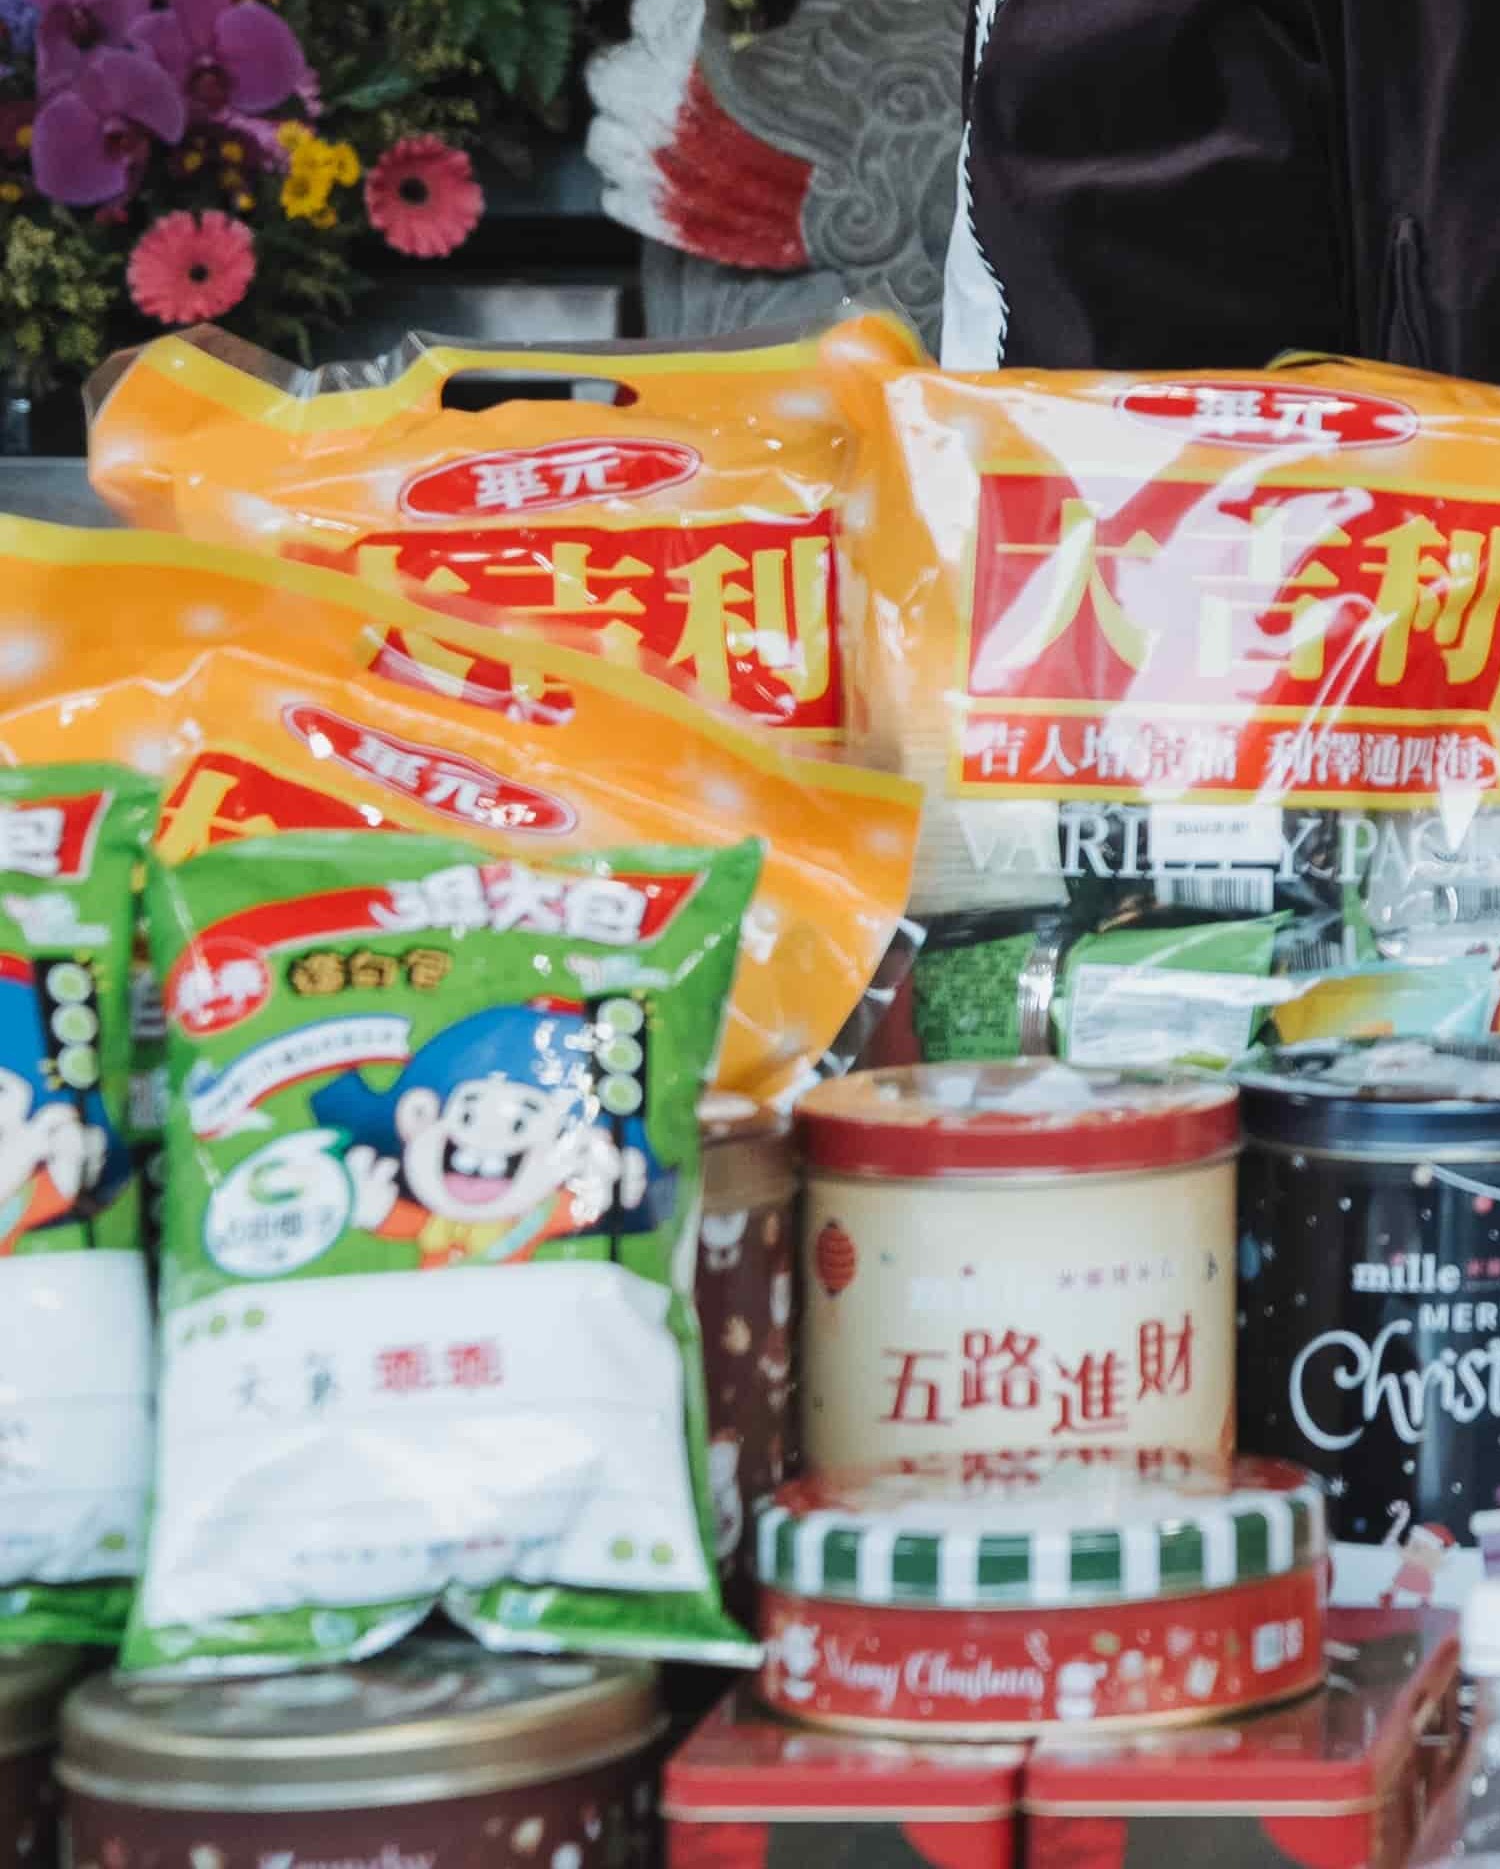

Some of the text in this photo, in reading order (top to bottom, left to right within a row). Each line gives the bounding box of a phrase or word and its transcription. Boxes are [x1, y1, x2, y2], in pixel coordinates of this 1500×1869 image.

[1195, 388, 1354, 441] 華元
[470, 444, 629, 509] 華元
[956, 805, 1326, 882] VARIY
[1352, 1251, 1461, 1294] mille
[372, 1341, 504, 1394] 乖乖
[879, 1308, 1196, 1437] 五路進財
